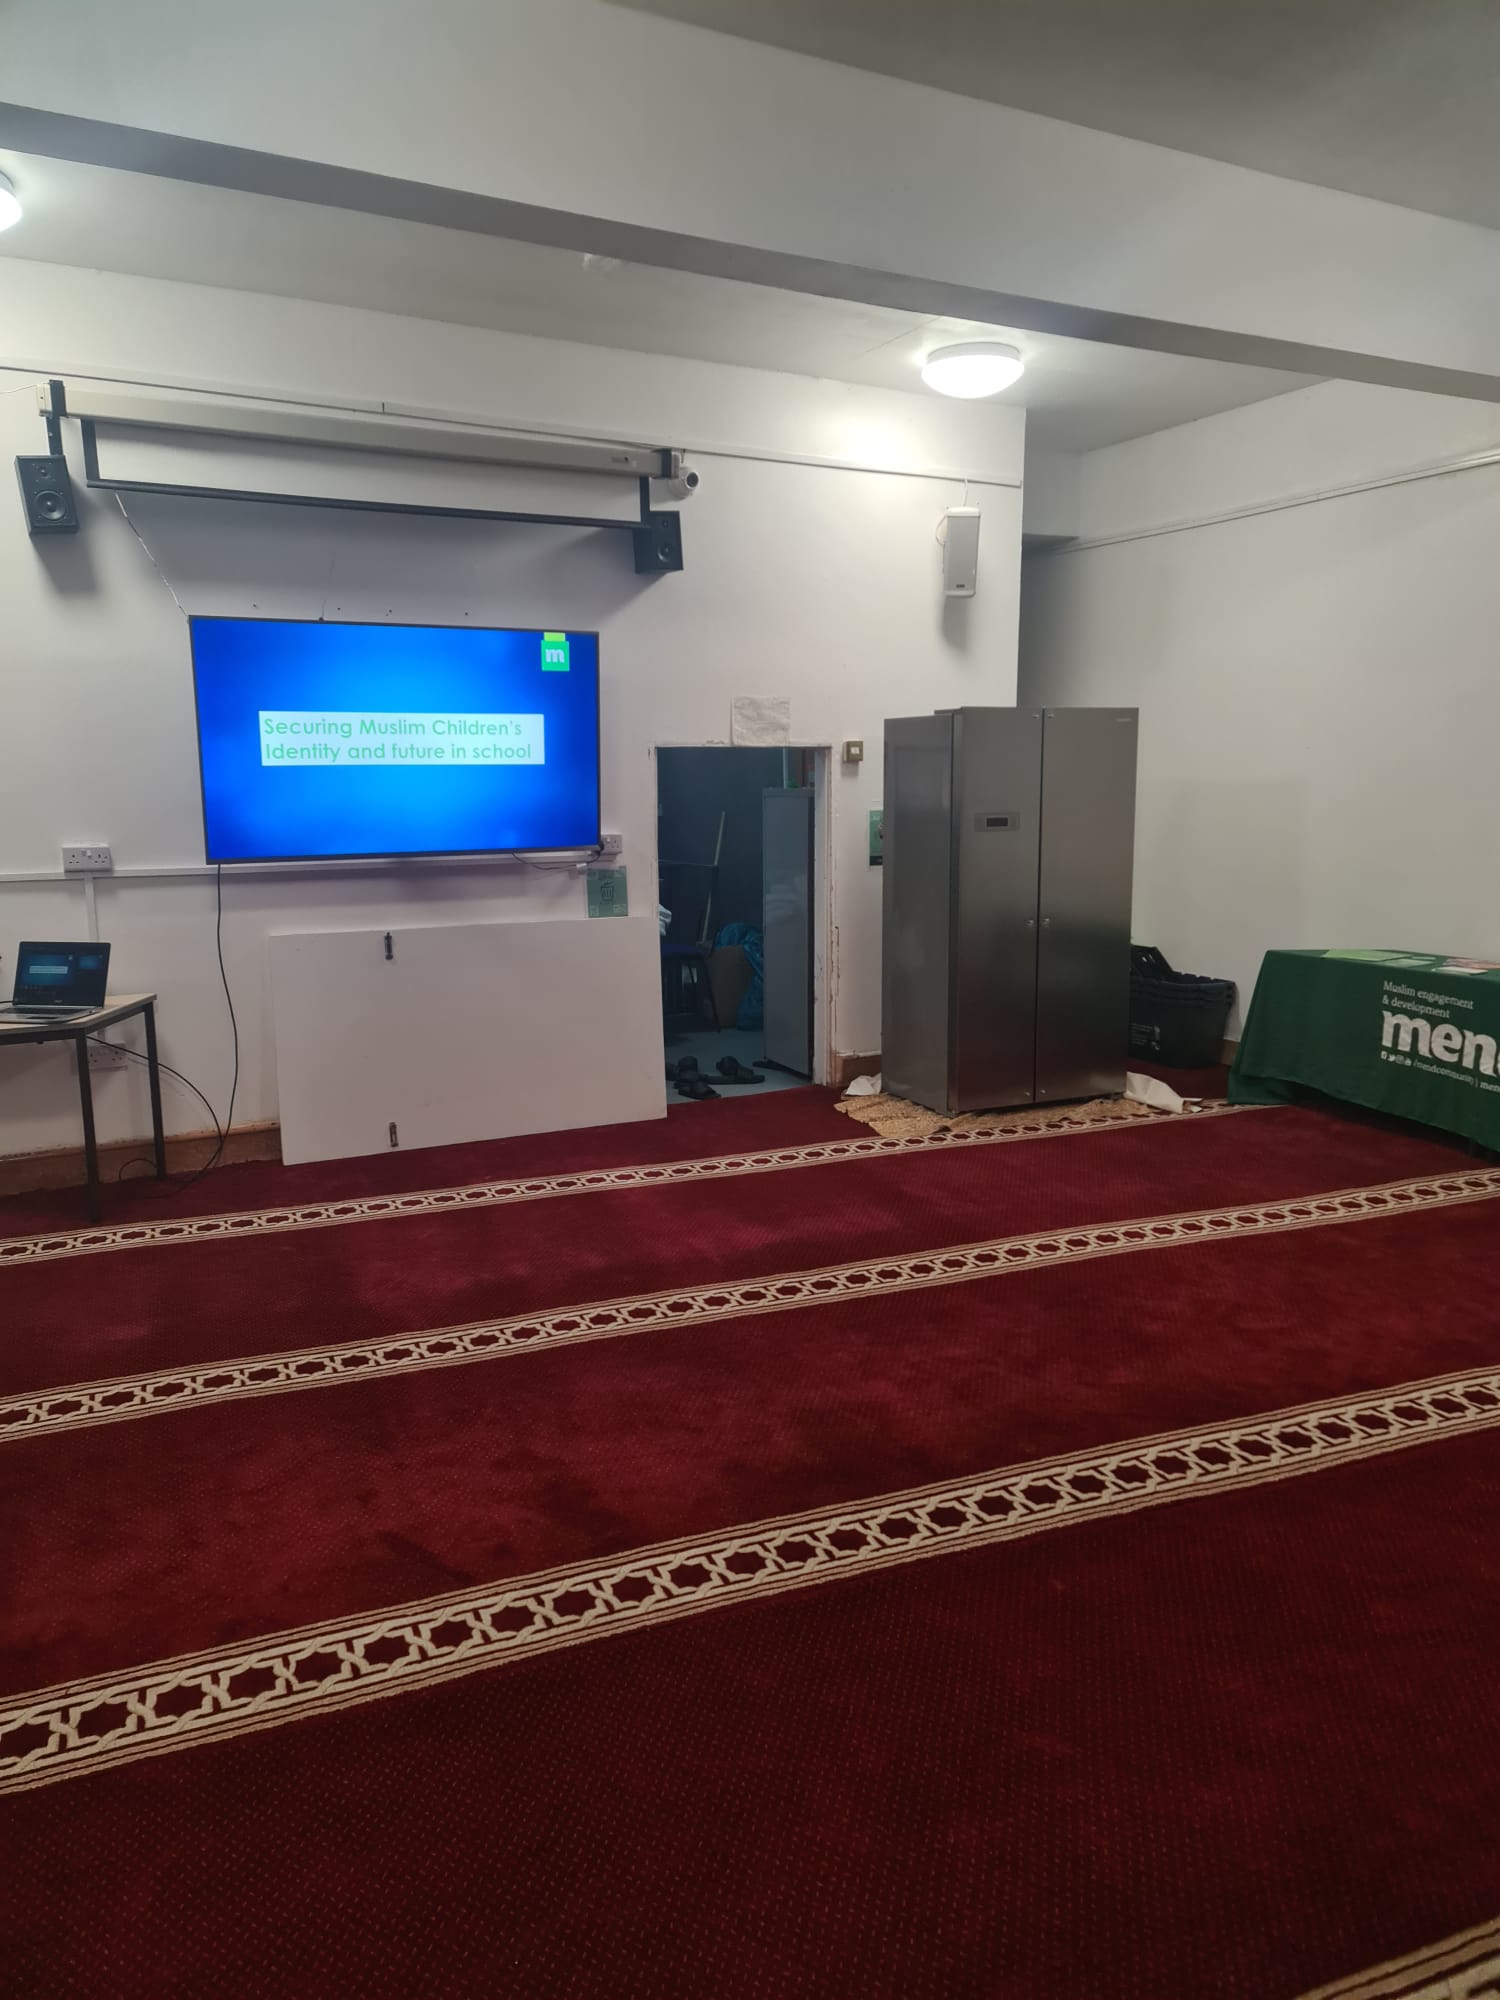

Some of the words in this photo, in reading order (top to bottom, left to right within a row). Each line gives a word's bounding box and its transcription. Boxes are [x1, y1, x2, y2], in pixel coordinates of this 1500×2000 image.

[545, 649, 565, 663] m
[264, 718, 352, 738] Securing
[360, 719, 426, 735] Muslim
[432, 719, 522, 735] Children's
[265, 743, 340, 763] Identity
[347, 743, 385, 759] and
[391, 743, 445, 759] future
[451, 743, 466, 759] in
[472, 743, 531, 759] school
[1383, 980, 1415, 997] Muslim
[1417, 990, 1474, 1009] engagement
[1382, 995, 1389, 1005] &
[1391, 997, 1450, 1018] development
[1381, 1010, 1500, 1077] men
